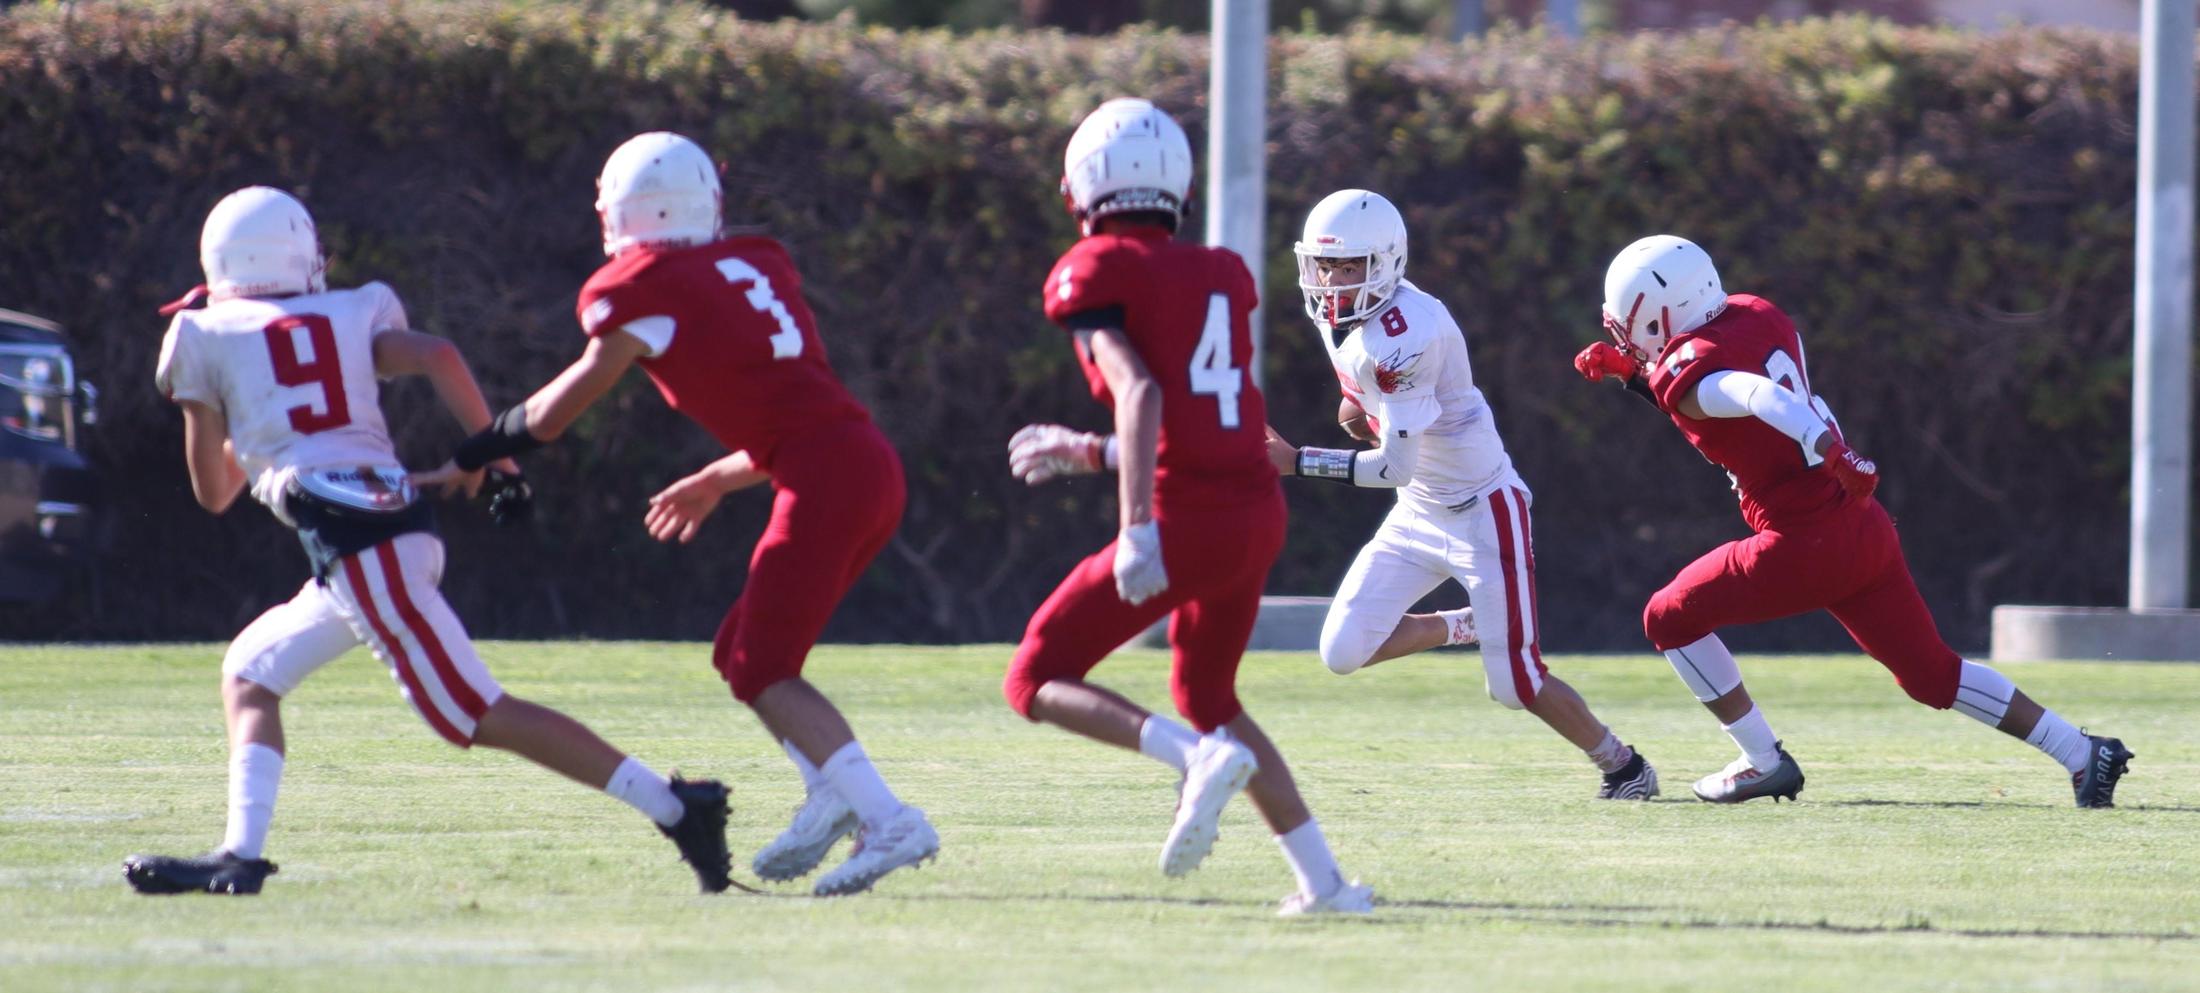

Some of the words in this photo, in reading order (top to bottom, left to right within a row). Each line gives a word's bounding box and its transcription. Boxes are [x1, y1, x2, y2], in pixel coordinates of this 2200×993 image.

[714, 257, 804, 359] 3
[1188, 292, 1242, 429] 4
[1380, 305, 1408, 337] 8
[263, 313, 352, 435] 9
